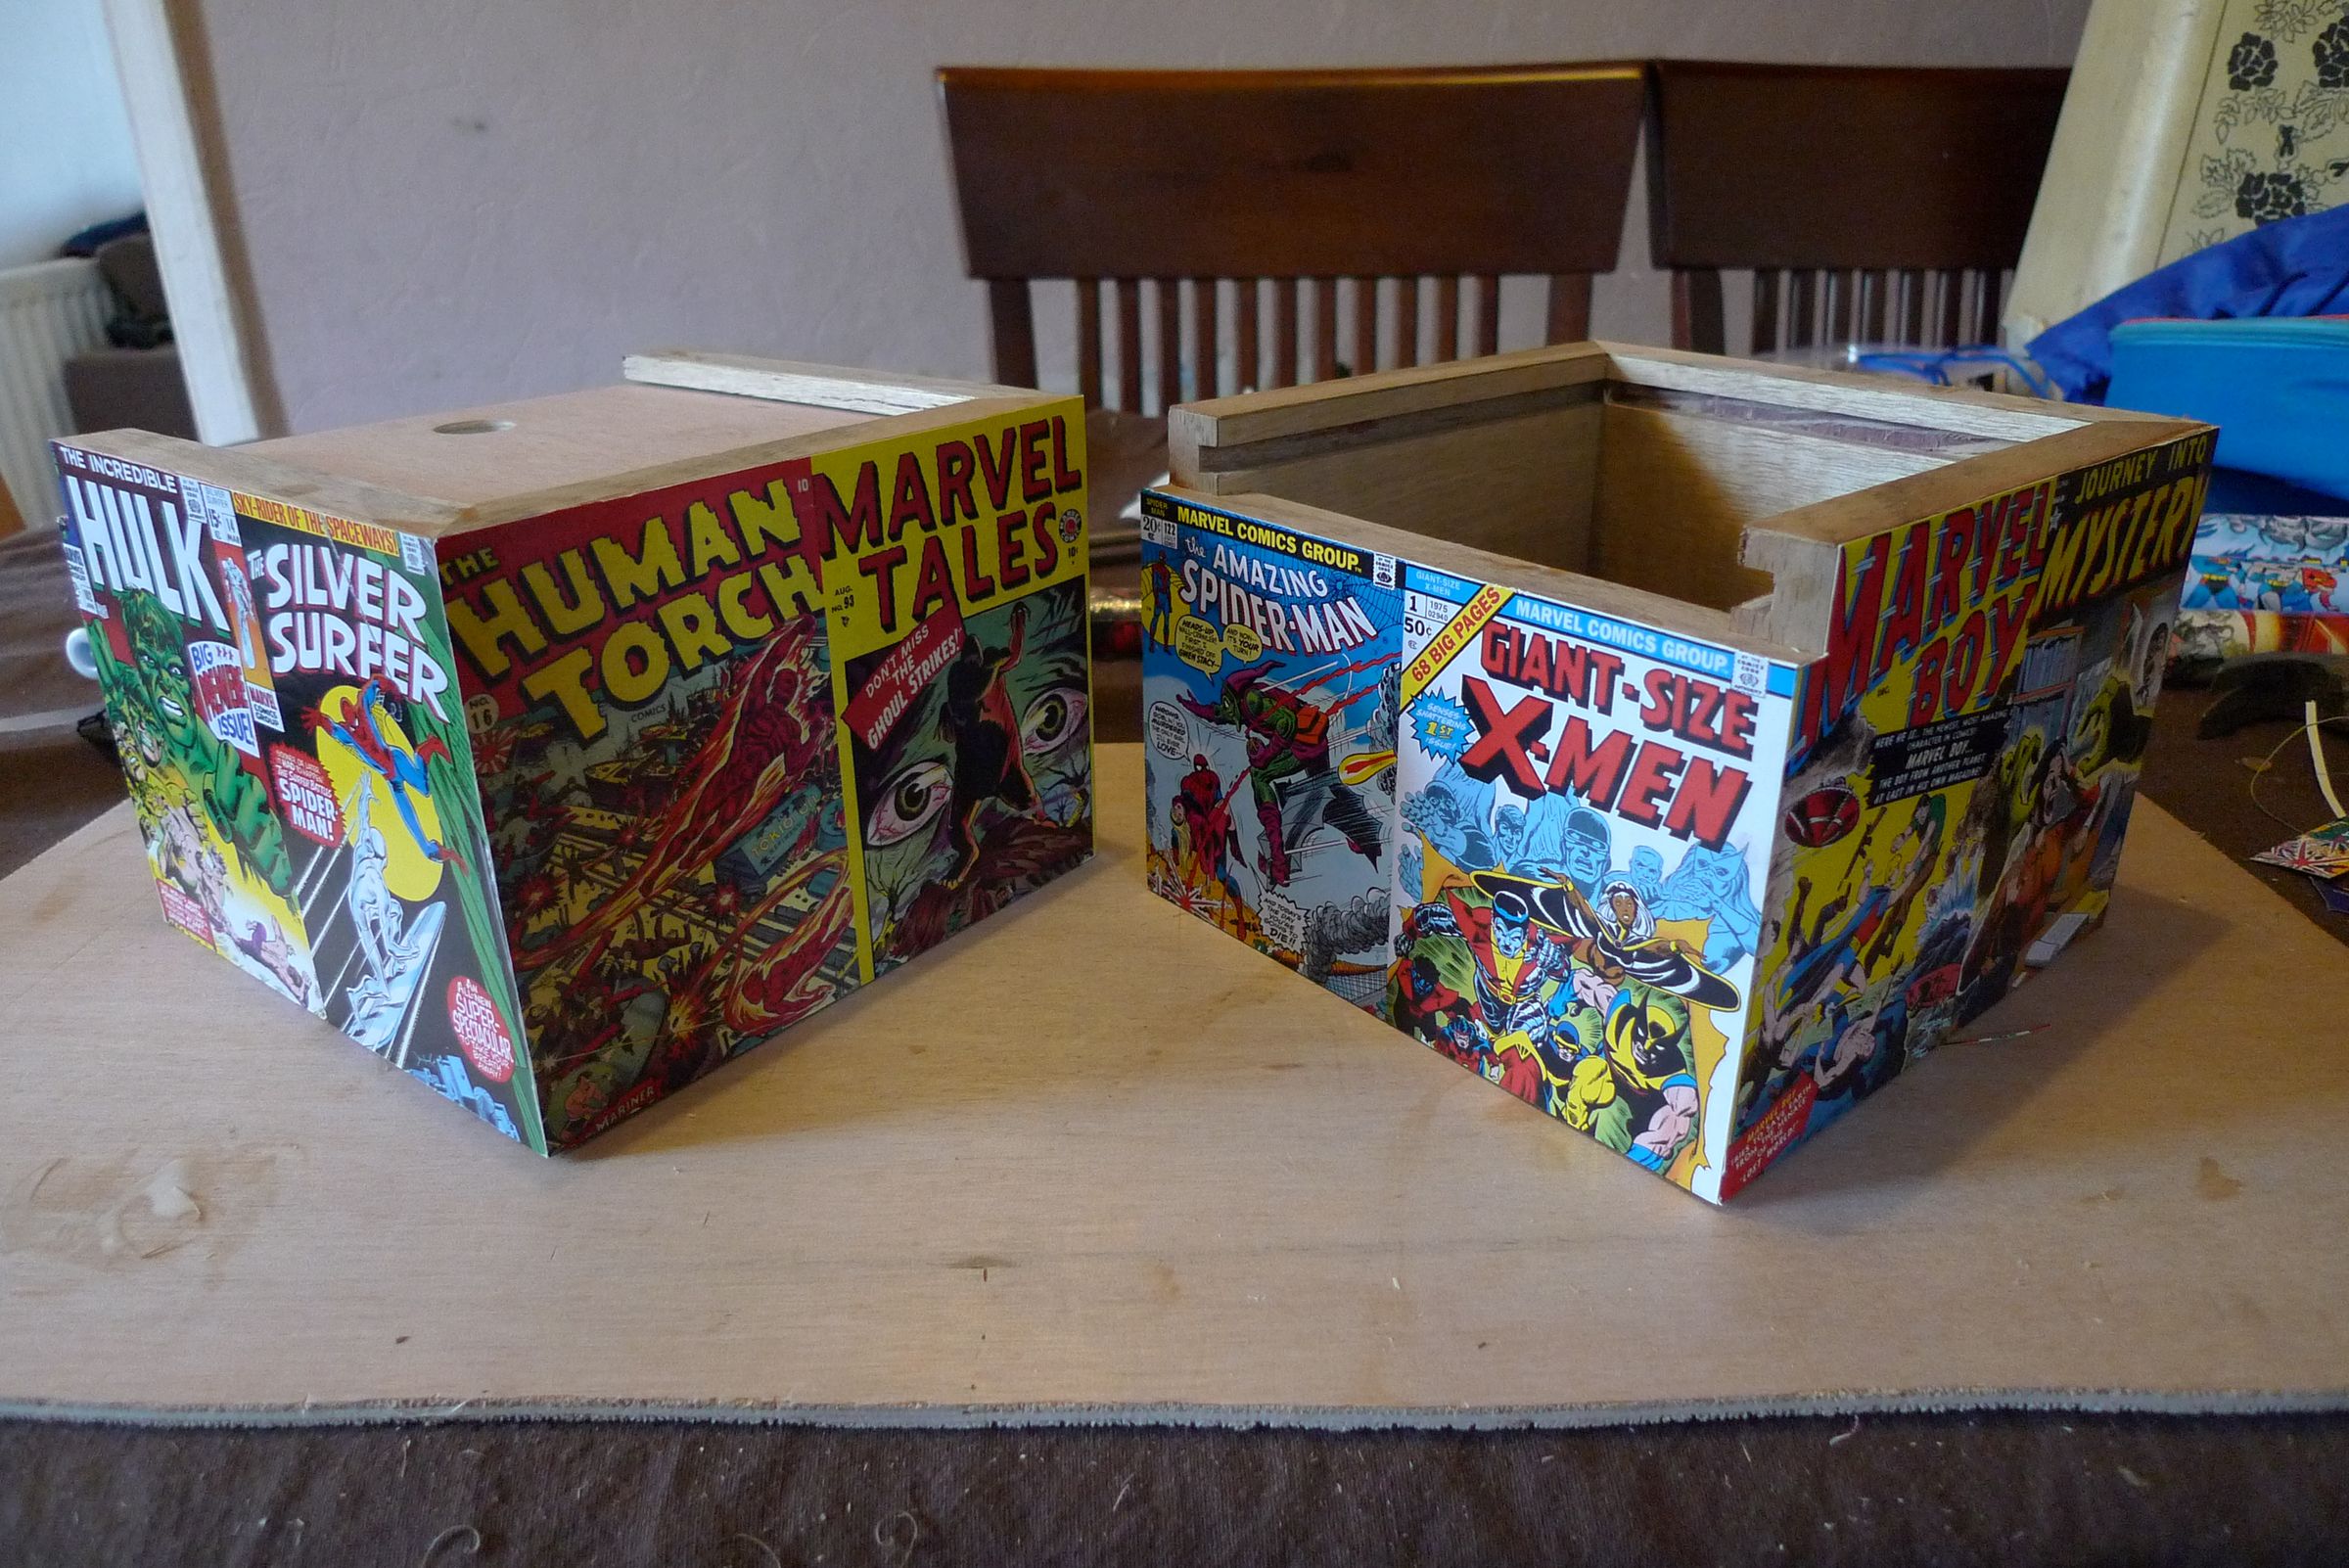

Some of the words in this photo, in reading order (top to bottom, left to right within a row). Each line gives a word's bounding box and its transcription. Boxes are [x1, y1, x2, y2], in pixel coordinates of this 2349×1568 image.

[59, 446, 86, 469] THE
[87, 454, 178, 494] INCREDIBLE
[2074, 449, 2160, 505] JOURNEY
[2167, 435, 2210, 473] INTO
[811, 415, 1082, 562] MARVEL
[233, 492, 287, 526] SKY-RIDER
[287, 506, 300, 530] OF
[301, 510, 326, 534] THE
[326, 516, 398, 555] SPACEWAYS!
[1143, 516, 1161, 533] 20¢
[1151, 507, 1166, 517] MAN
[1164, 523, 1175, 535] 122
[1177, 506, 1233, 536] MARVEL
[1237, 523, 1297, 554] COMICS
[1302, 540, 1359, 571] GROUP
[66, 475, 231, 633] HULK
[1185, 536, 1207, 558] the
[2029, 474, 2211, 620] MYSTERY
[247, 549, 265, 579] THE
[438, 548, 499, 587] THE
[445, 479, 804, 679] HUMAN
[858, 501, 1060, 635] TALES
[1213, 542, 1328, 598] AMAZING
[263, 542, 428, 644] SILVER
[1416, 571, 1461, 591] GIANT-SIZE
[1425, 583, 1451, 596] X-MEN
[844, 594, 854, 609] 93
[1180, 559, 1378, 655] SPIDER-MAN
[1408, 595, 1418, 613] 1
[1427, 611, 1449, 622] 02940
[1430, 600, 1449, 613] 1975
[1227, 627, 1238, 636] AND
[1404, 616, 1433, 637] 50¢
[1410, 659, 1432, 683] 68
[1428, 633, 1456, 666] BIG
[1452, 586, 1502, 640] PAGES
[1515, 599, 1584, 633] MARVEL
[1588, 621, 1657, 654] COMICS
[1662, 639, 1727, 672] GROUP
[1785, 482, 2051, 779] MARVEL
[191, 643, 213, 671] BIG
[523, 554, 826, 742] TORCH
[1238, 638, 1260, 652] YOUR
[1908, 581, 2038, 730] BOY
[269, 613, 451, 724] SURFER
[865, 656, 898, 699] DON'T
[900, 623, 930, 658] MISS
[1480, 621, 1759, 761] GIANT-SIZE
[470, 709, 494, 729] 16
[630, 704, 668, 724] COMICS
[867, 690, 908, 752] GHOUL
[1151, 717, 1187, 736] MURDERED
[1416, 709, 1467, 730] SHATTERING
[217, 713, 255, 747] ISSUE!
[1425, 721, 1454, 739] 1ST
[1425, 737, 1457, 751] ISSUE!
[1874, 734, 1895, 750] HERE
[1895, 732, 1908, 745] HE
[1981, 709, 2009, 723] AMAZING
[1907, 736, 1943, 751] CHARACTER
[1458, 674, 1752, 853] X-MEN
[1906, 746, 1946, 770] MARVEL
[1879, 778, 1894, 790] THE
[1894, 774, 1910, 788] BOY
[1910, 767, 1931, 782] FROM
[1931, 759, 1961, 776] ANOTHER
[1873, 793, 1885, 806] AT
[1885, 787, 1904, 803] LAST
[292, 805, 335, 842] MAN!
[1265, 899, 1277, 907] AND
[1276, 902, 1303, 922] TODAY'S
[1267, 904, 1281, 916] THE
[1280, 911, 1296, 924] DAY
[1268, 912, 1295, 931] YOU'RE
[1265, 917, 1288, 935] GOING
[1288, 930, 1299, 940] TO
[1269, 927, 1298, 946] DIE!!
[466, 978, 479, 993] AN
[456, 992, 501, 1034] SUPER-
[453, 1009, 515, 1064] SPECTACULAR
